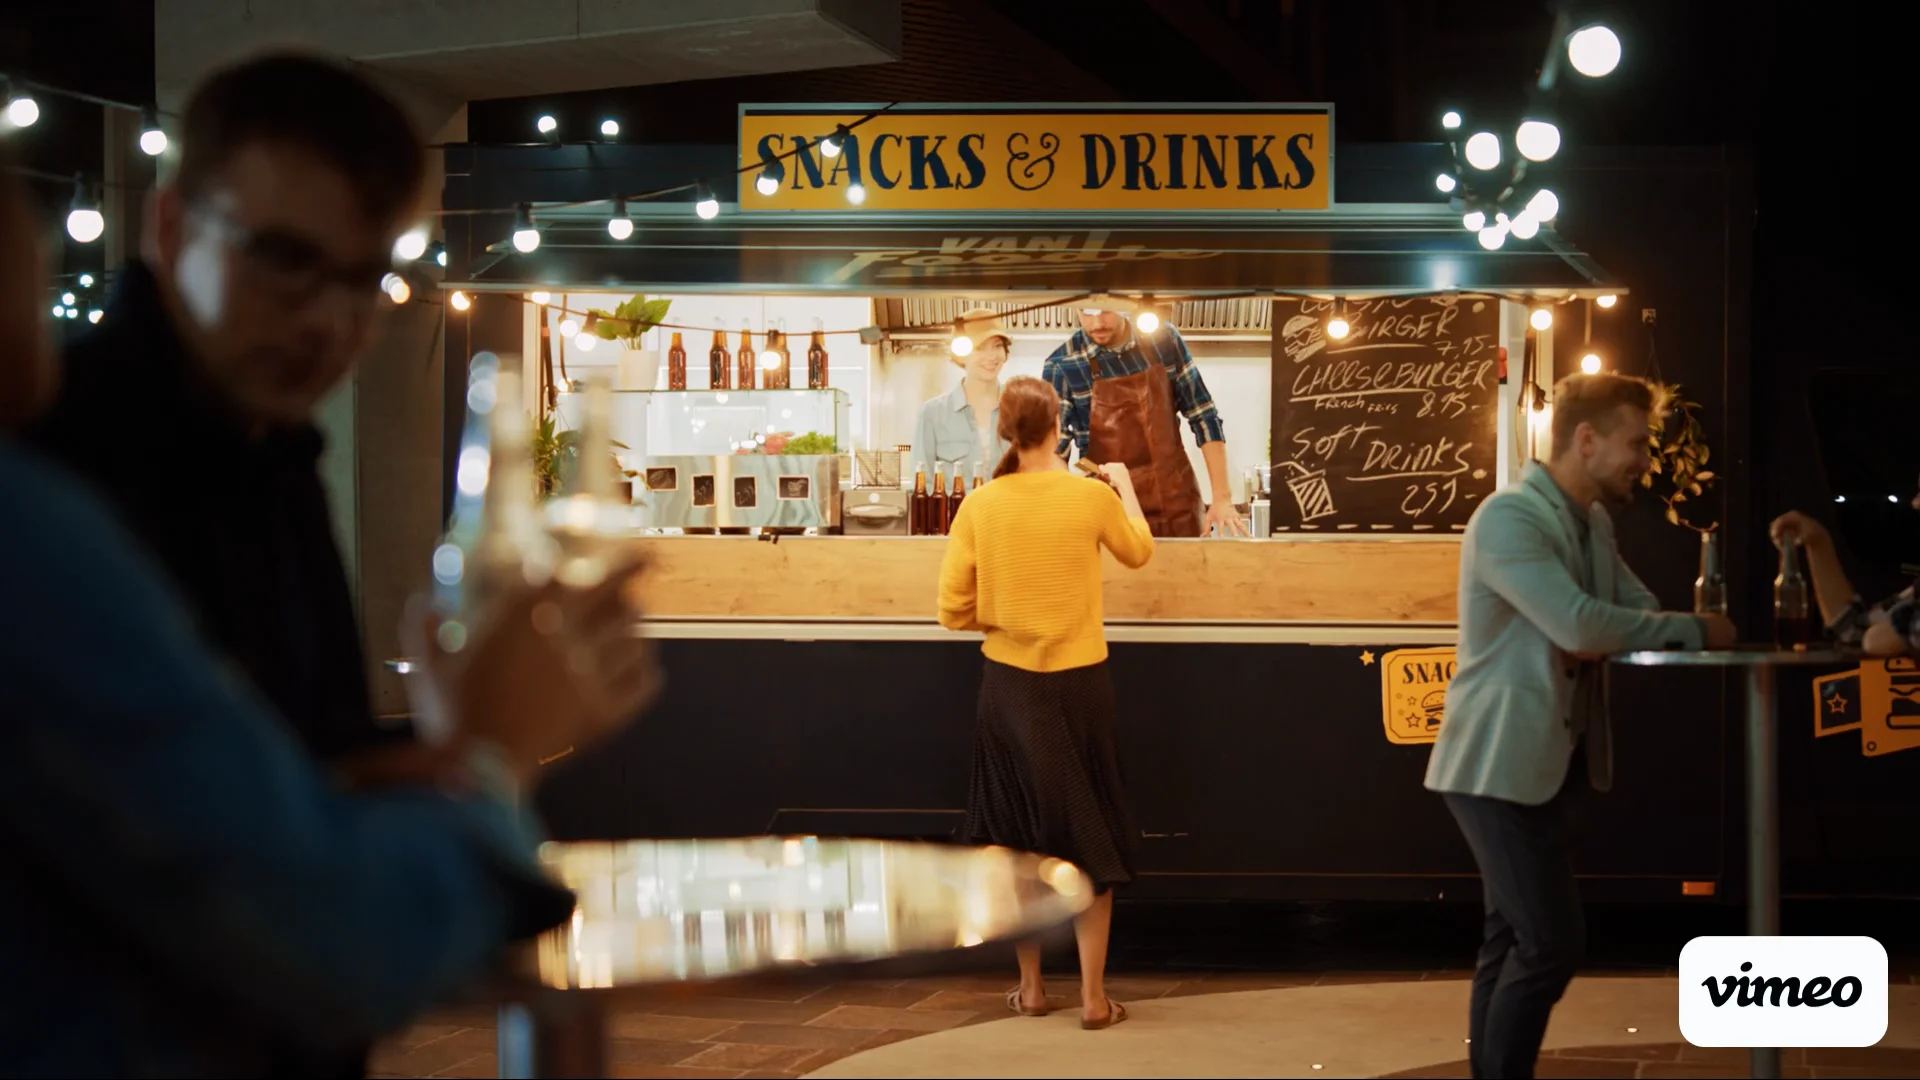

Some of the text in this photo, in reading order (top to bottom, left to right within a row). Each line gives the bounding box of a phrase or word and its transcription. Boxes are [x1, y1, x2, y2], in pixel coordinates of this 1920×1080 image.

[756, 132, 1316, 191] SNACKS & DRINKS
